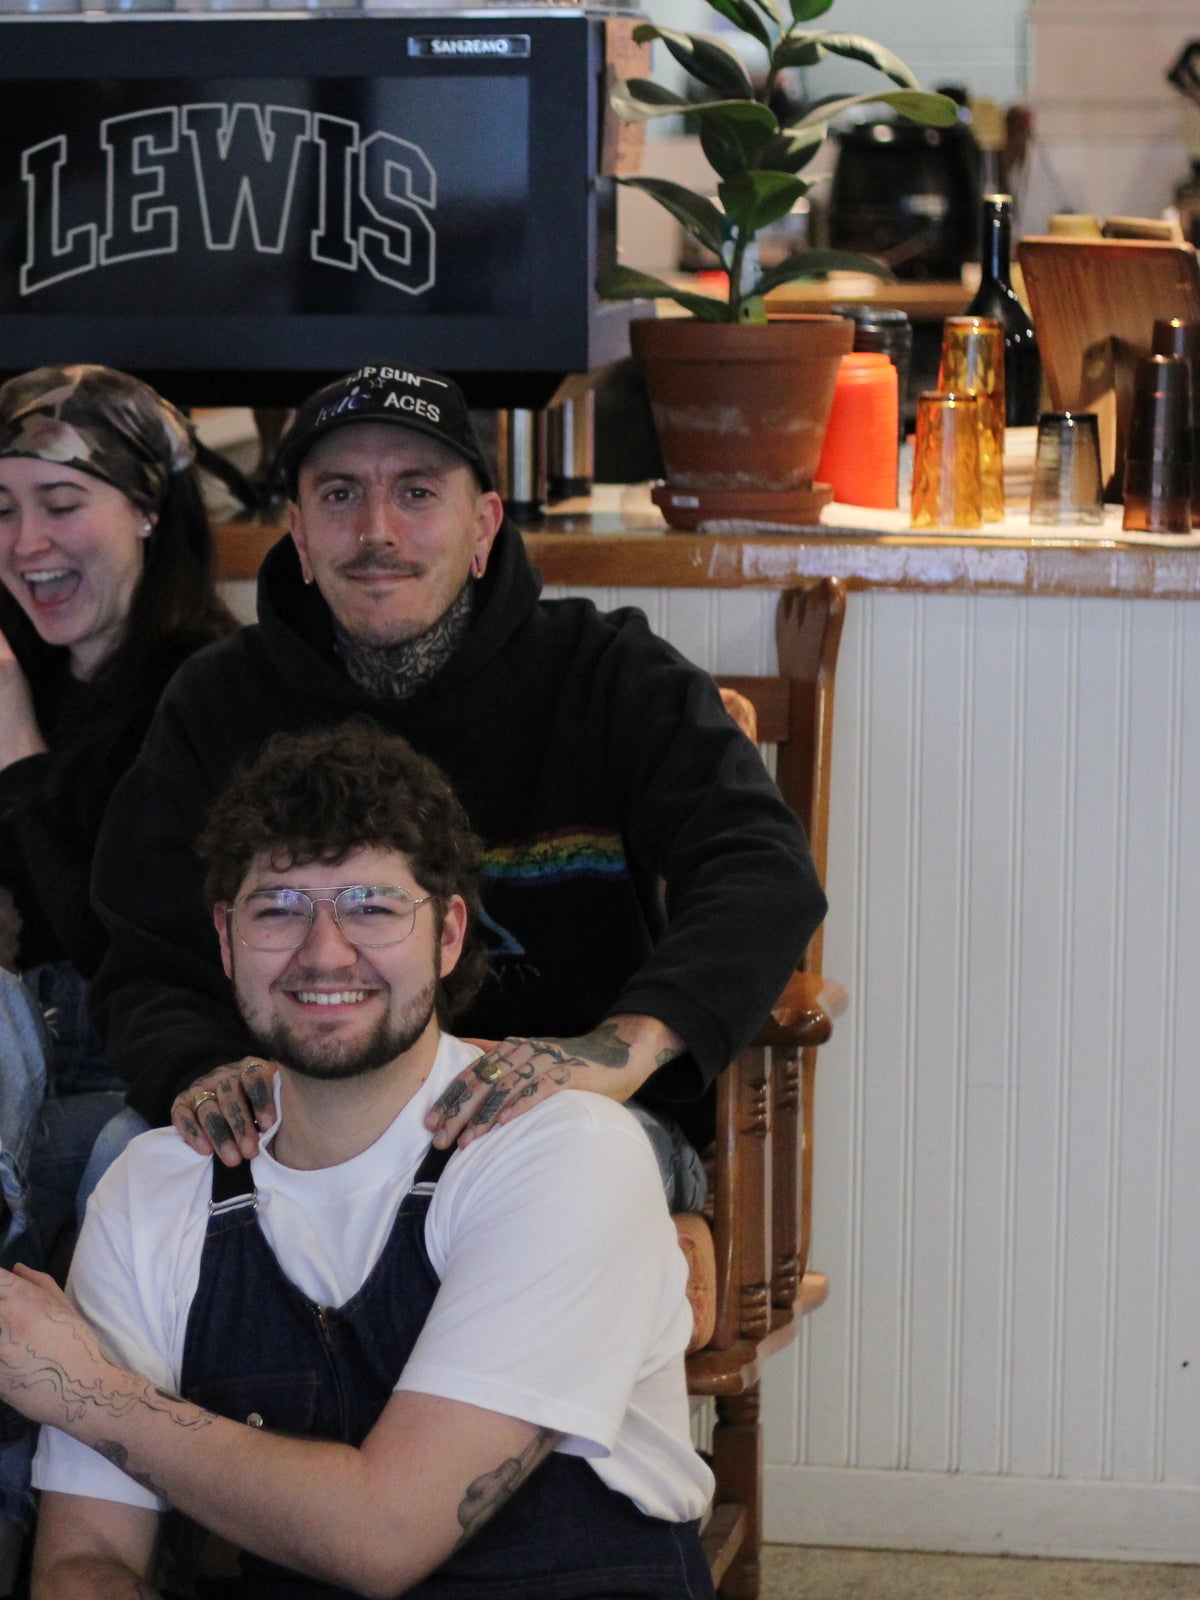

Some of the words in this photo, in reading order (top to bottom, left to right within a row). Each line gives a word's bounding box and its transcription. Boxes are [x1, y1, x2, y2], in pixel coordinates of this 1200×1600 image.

[20, 102, 437, 296] LEWIS
[379, 366, 422, 388] GUN
[383, 391, 441, 423] ACES
